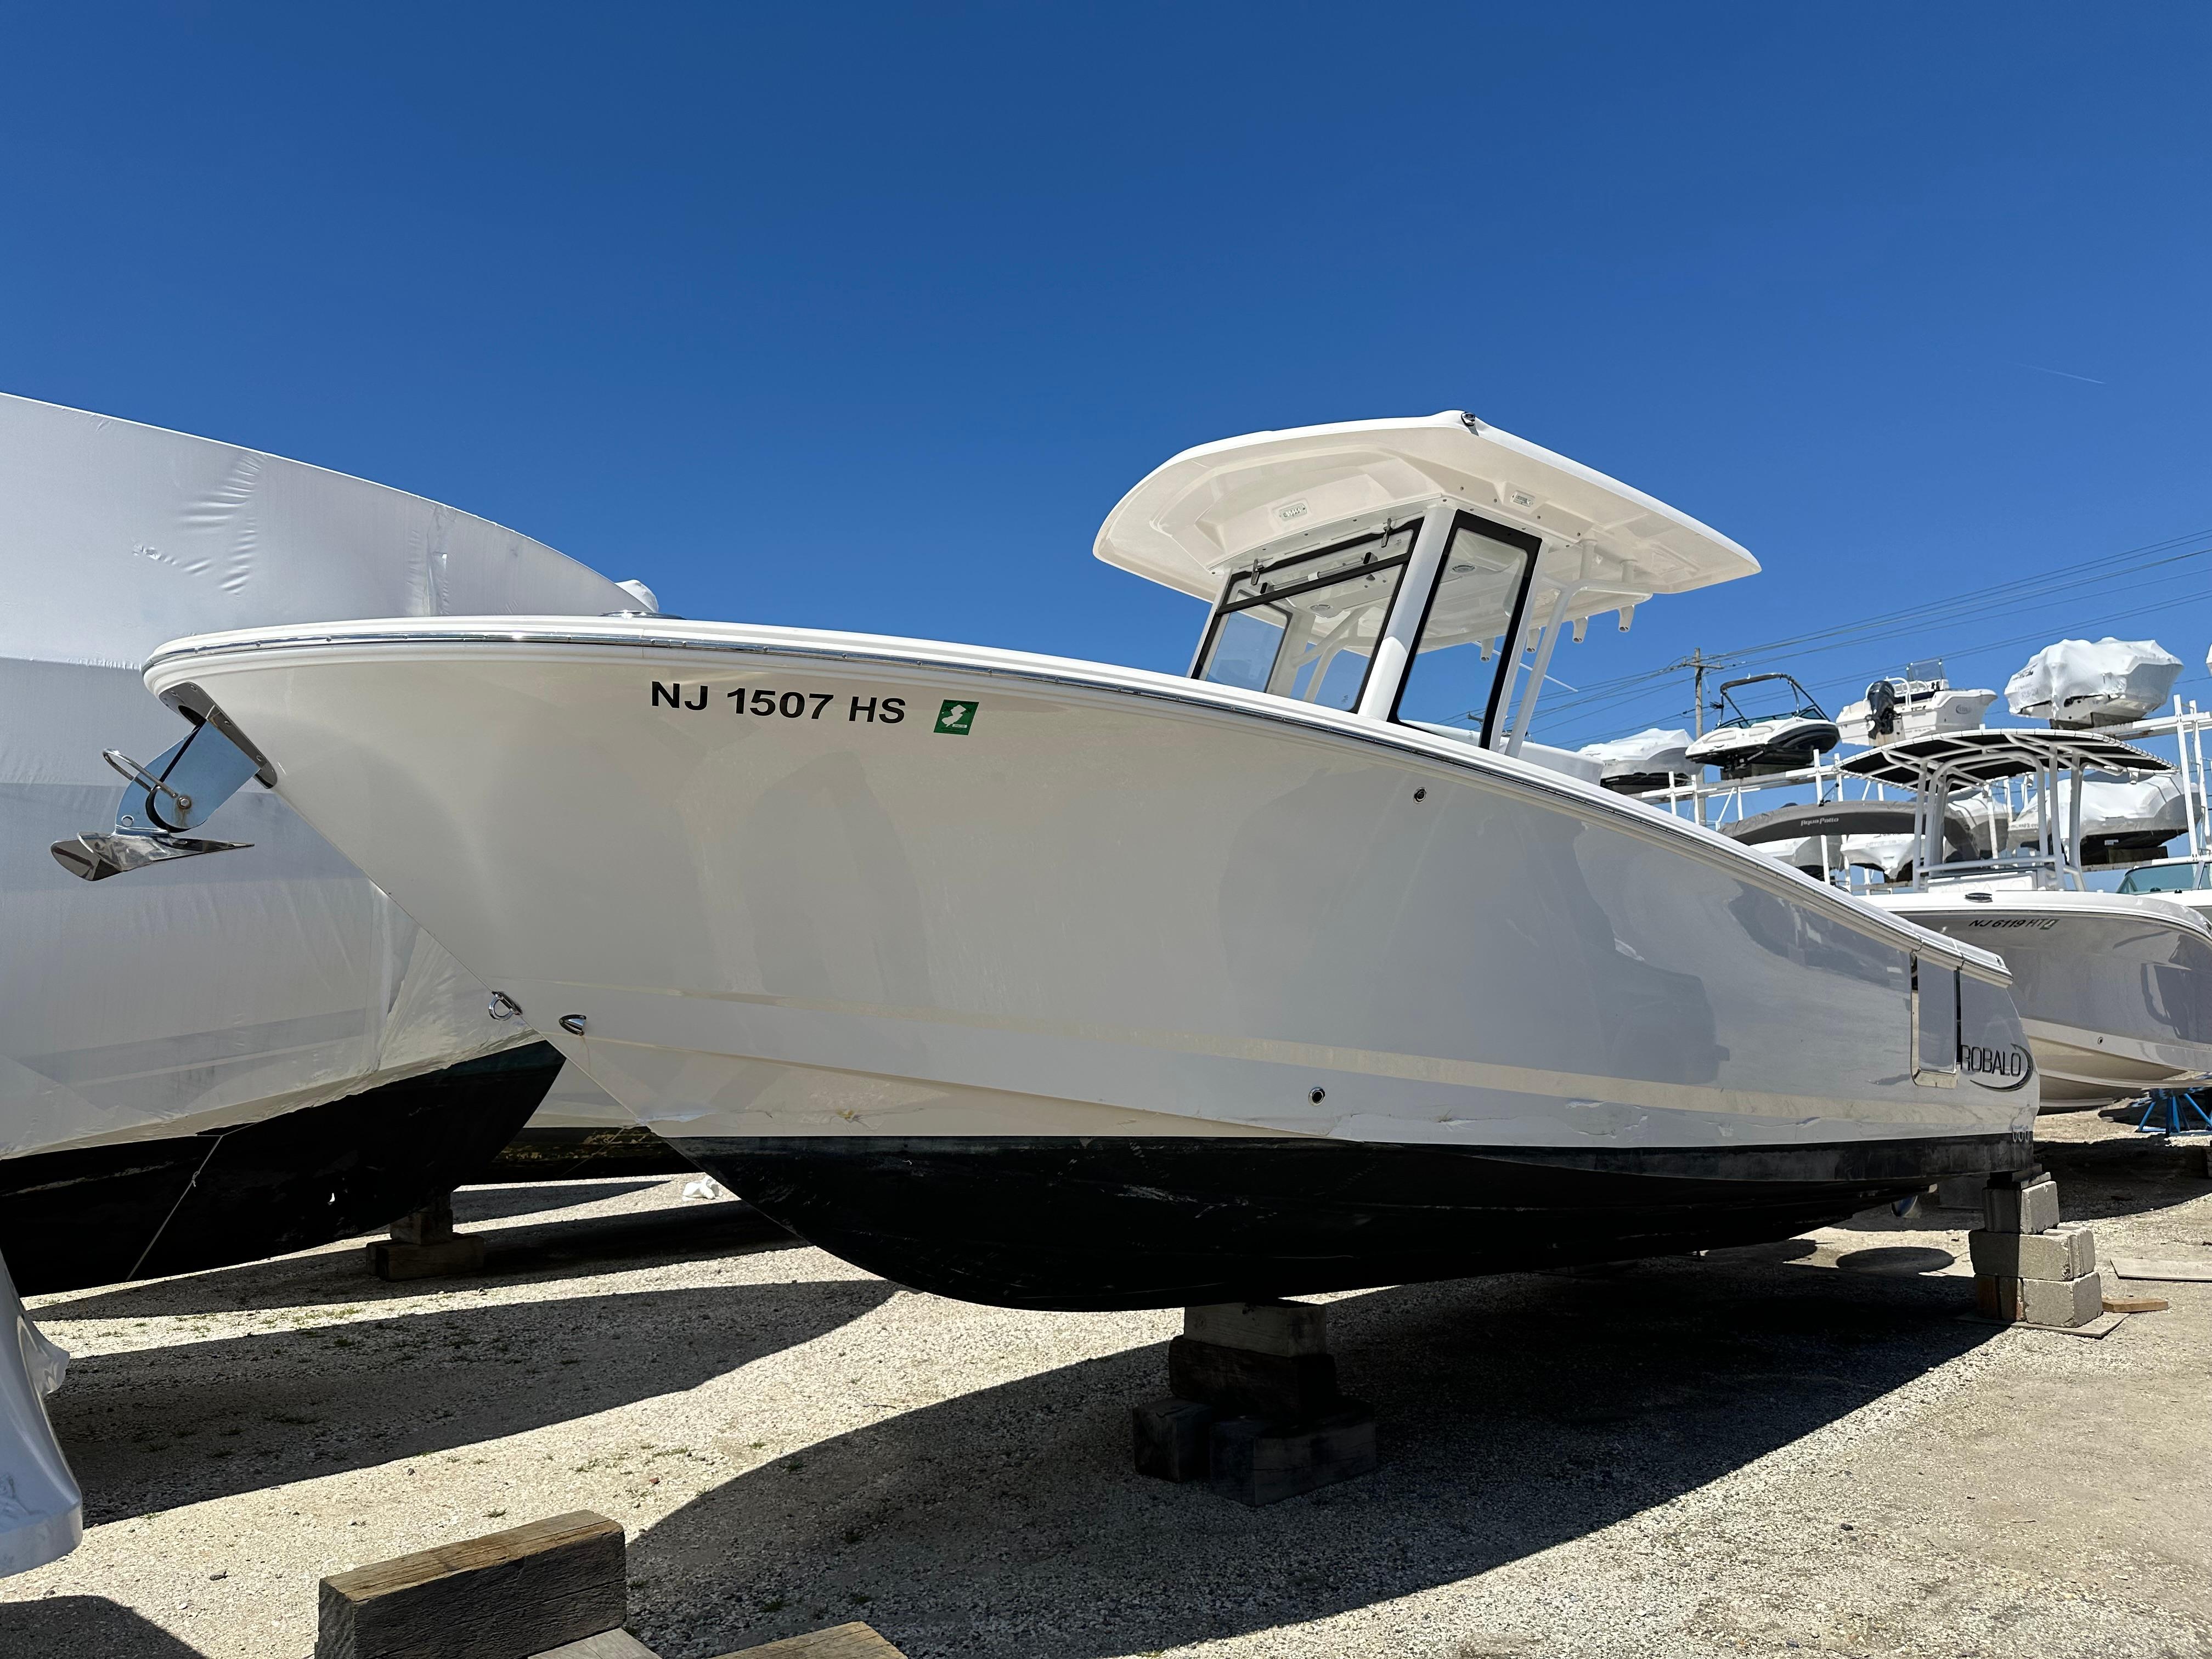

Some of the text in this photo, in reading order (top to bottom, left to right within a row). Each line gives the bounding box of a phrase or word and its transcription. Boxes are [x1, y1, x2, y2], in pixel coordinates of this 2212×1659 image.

[652, 681, 906, 724] NJ 1507 HS
[1991, 919, 2027, 928] 6119
[1960, 1044, 2022, 1077] ROBALO
